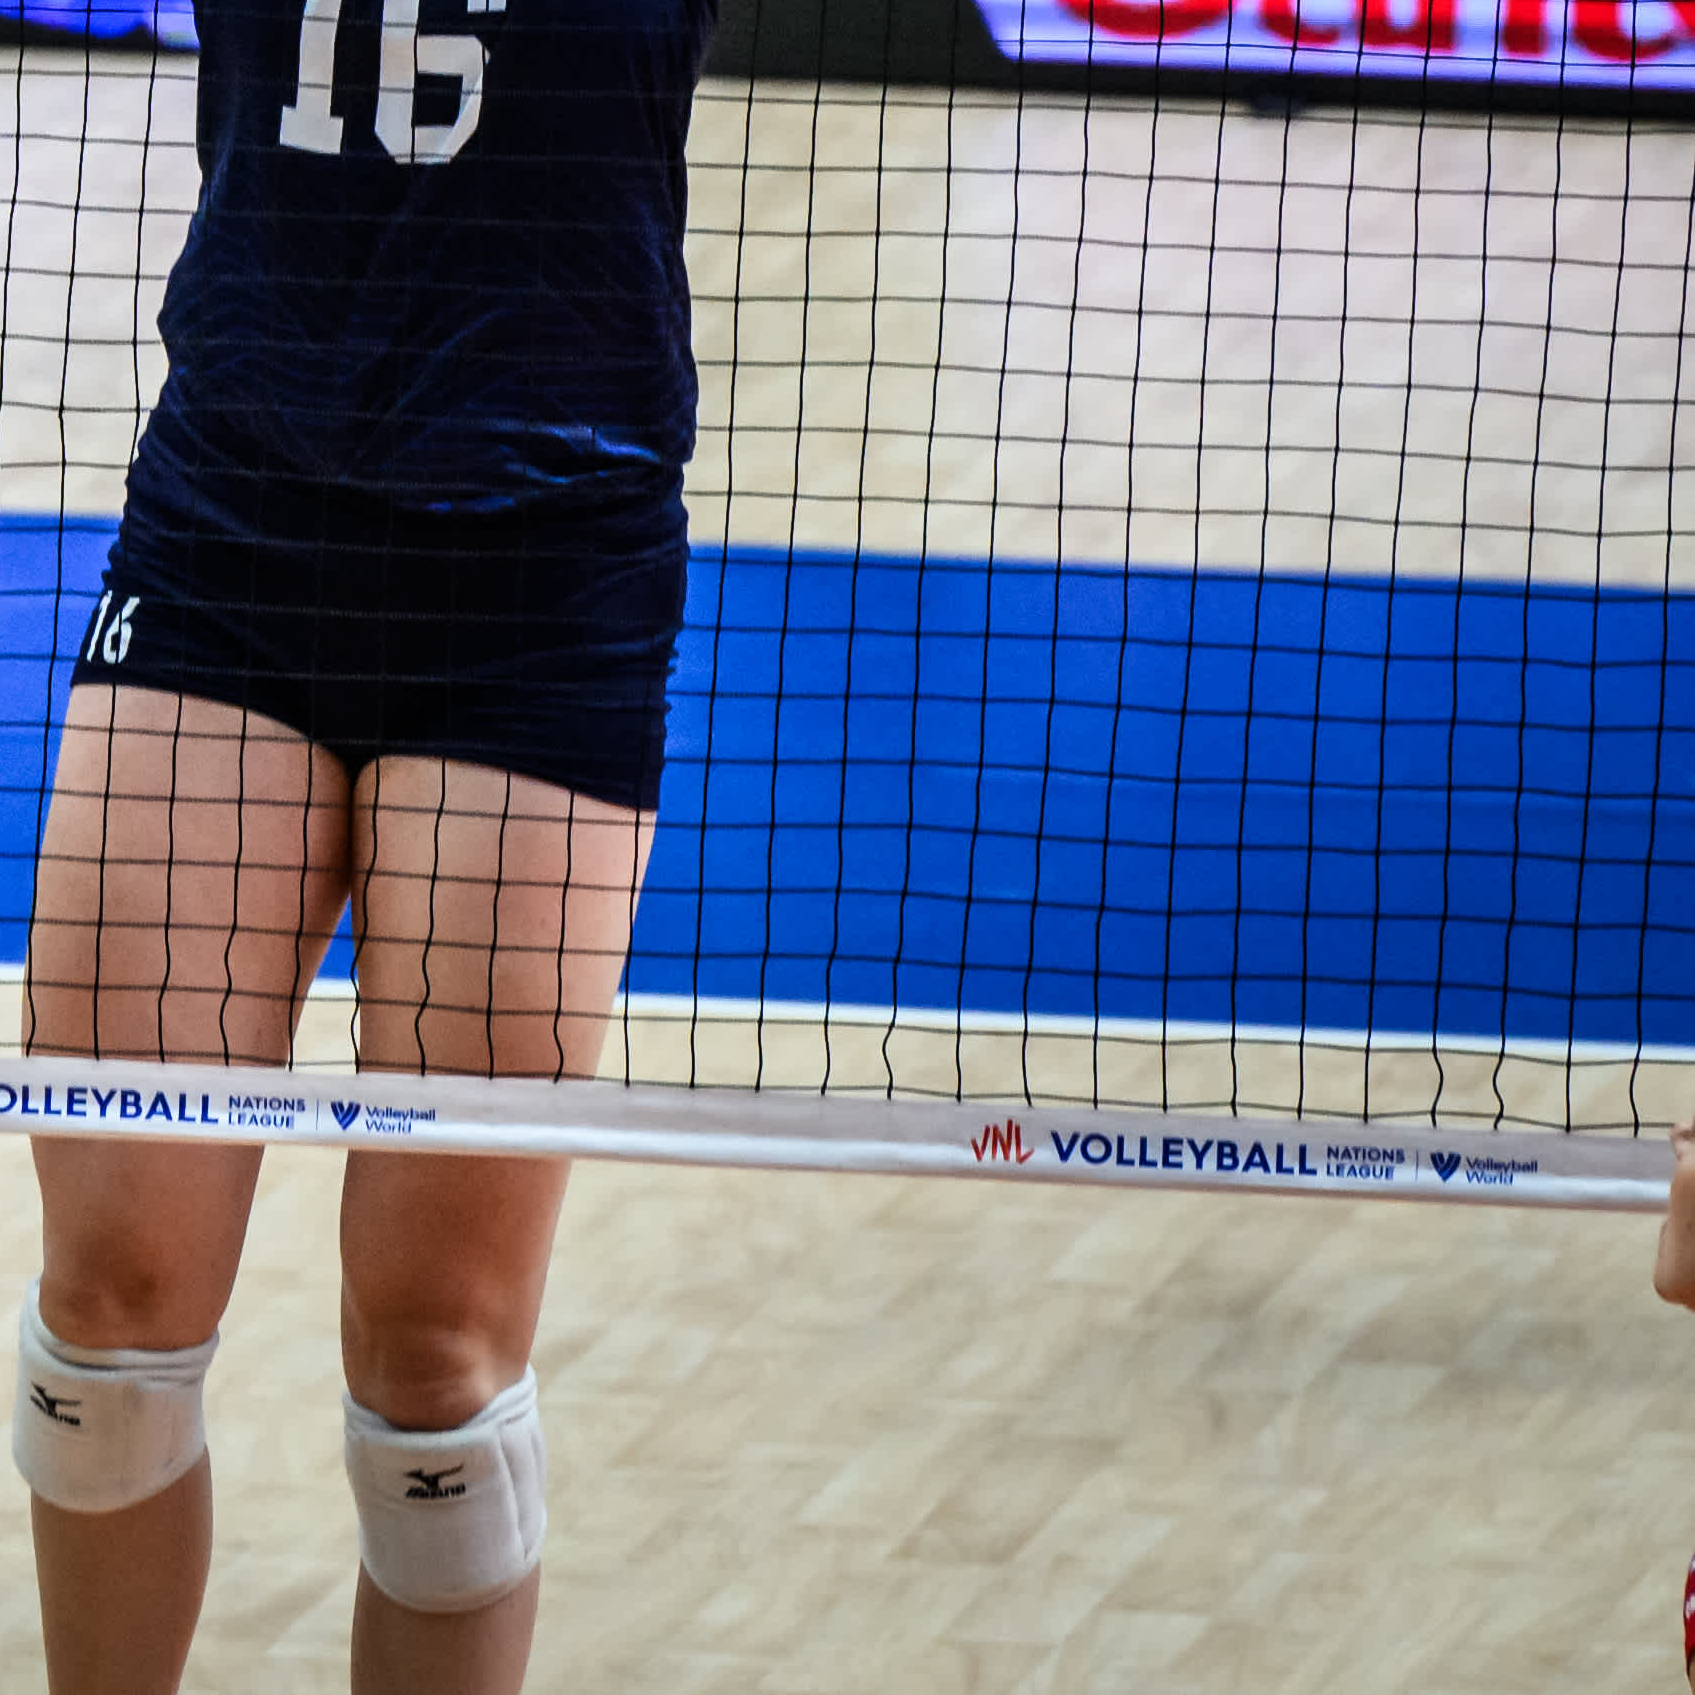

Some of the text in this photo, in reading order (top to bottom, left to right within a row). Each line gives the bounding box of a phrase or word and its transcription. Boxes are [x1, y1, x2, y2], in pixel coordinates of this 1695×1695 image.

[87, 590, 140, 663] 16
[228, 1095, 306, 1113] NATIONS
[228, 1111, 295, 1130] LEAGUE
[366, 1105, 436, 1124] Volleyball
[366, 1119, 412, 1135] World
[970, 1119, 1318, 1176] VNL VOLLEYBALL
[1326, 1145, 1405, 1164] NATIONS
[1326, 1163, 1395, 1181] LEAGUE
[1466, 1156, 1538, 1174] Volleyball
[1466, 1170, 1513, 1187] World
